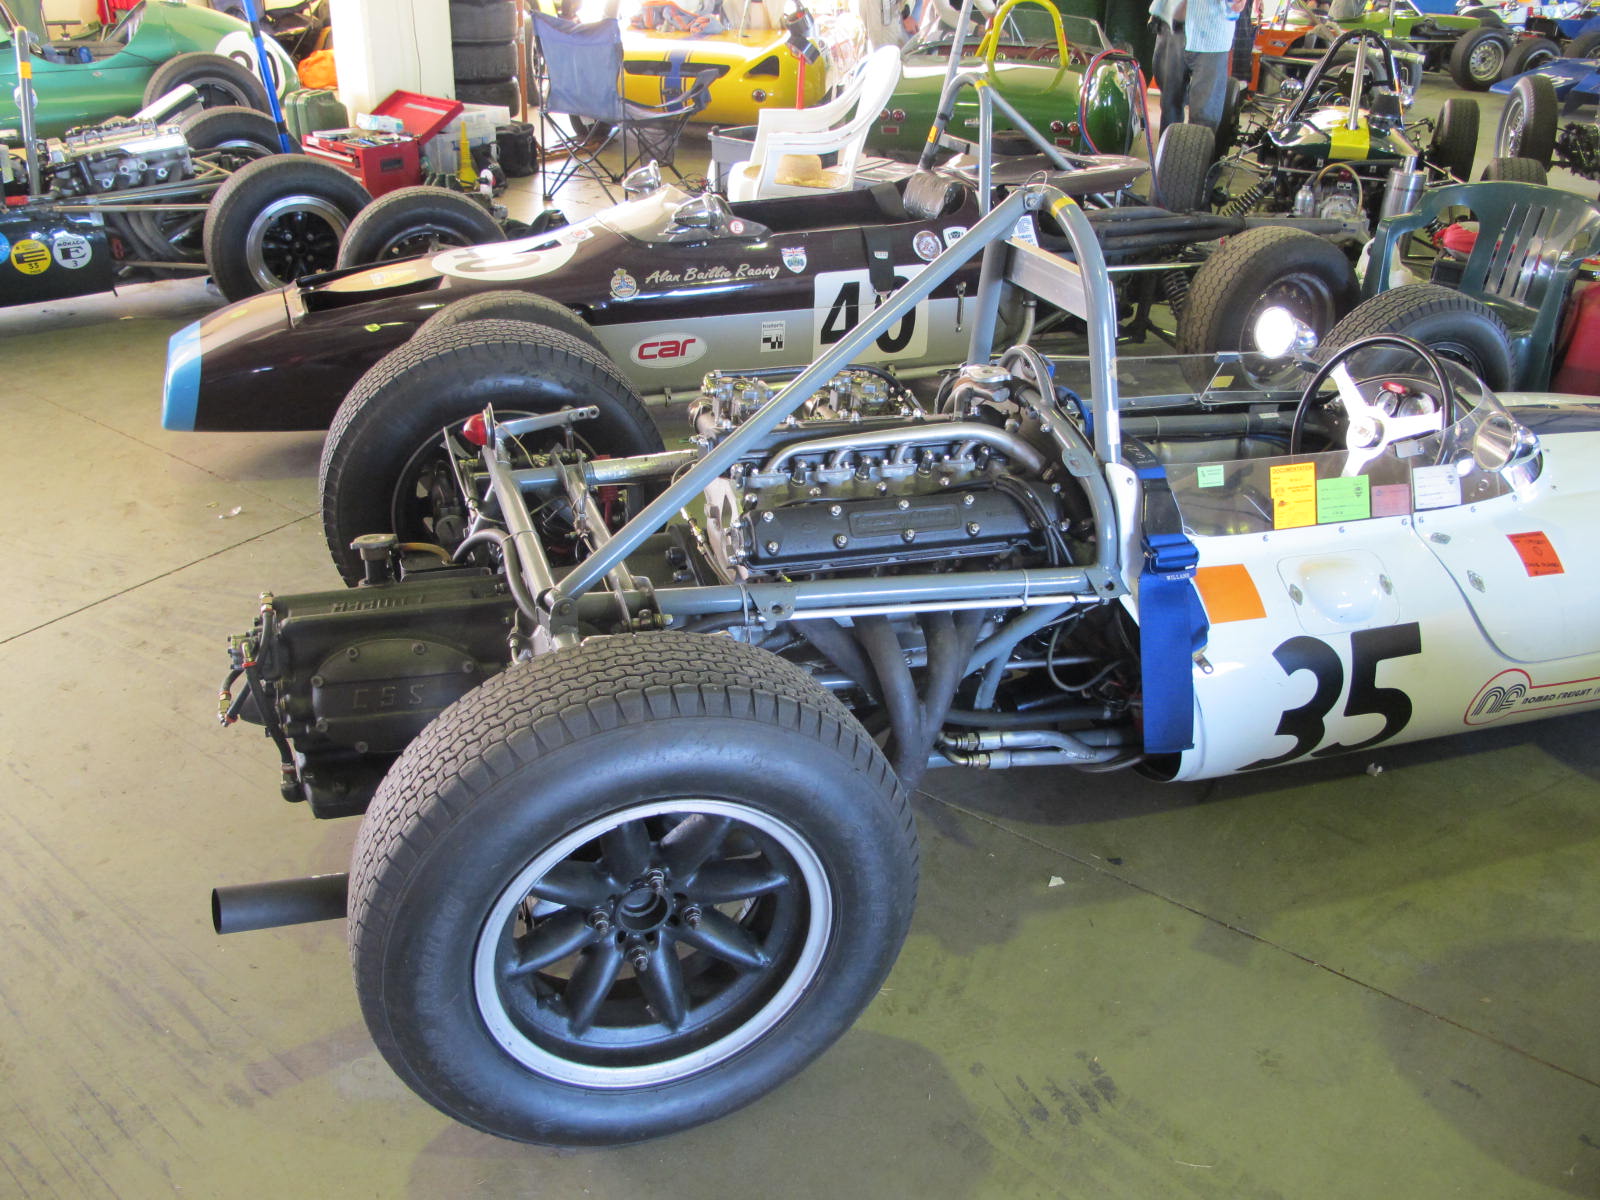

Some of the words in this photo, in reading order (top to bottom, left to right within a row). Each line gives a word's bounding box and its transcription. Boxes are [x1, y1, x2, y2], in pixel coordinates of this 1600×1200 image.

[645, 270, 681, 284] Alan
[684, 265, 733, 282] Baillie
[735, 263, 780, 279] Racing
[637, 338, 697, 360] car
[1234, 621, 1422, 771] 35
[1555, 687, 1593, 700] FREIGHT
